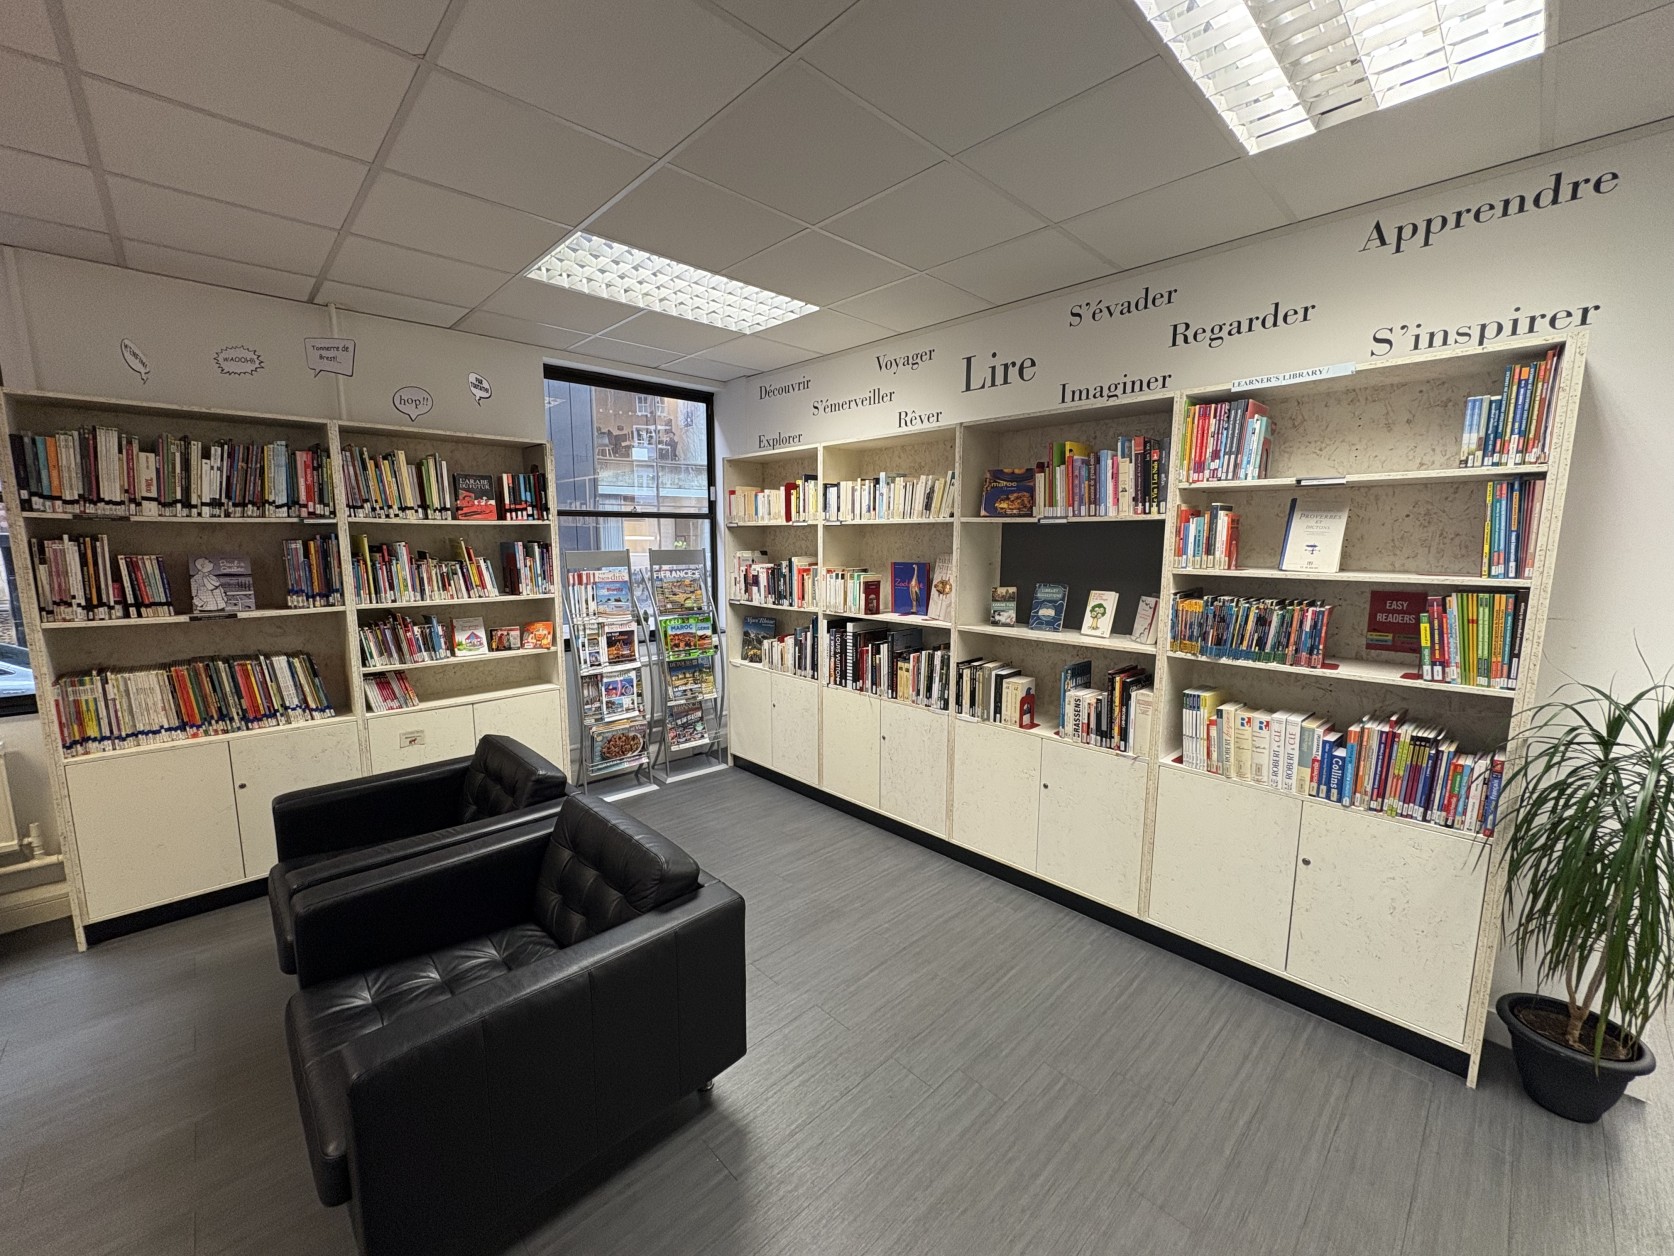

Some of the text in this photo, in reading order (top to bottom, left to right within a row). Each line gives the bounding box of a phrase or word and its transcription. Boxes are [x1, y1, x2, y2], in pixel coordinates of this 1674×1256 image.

[1361, 167, 1621, 255] Apprendre
[1069, 285, 1178, 328] S'évader
[1169, 302, 1317, 349] Regarder
[1370, 304, 1602, 359] S'inspirer
[311, 344, 350, 352] Tonnerre de
[876, 349, 935, 375] Voyager
[961, 351, 1037, 393] Lire
[759, 376, 811, 400] Découvrir
[1060, 372, 1172, 404] Imaginer
[1232, 375, 1280, 388] LEARNER'S
[1282, 368, 1325, 381] LIBRARY
[399, 395, 429, 410] hop!!
[812, 388, 895, 416] S'émerveiller
[897, 410, 943, 429] Rêver
[758, 432, 803, 450] Explorer
[1377, 613, 1416, 624] READERS
[1386, 601, 1408, 610] EASY
[1272, 750, 1281, 777] ROBERT
[1286, 753, 1295, 780] ROBERT
[1330, 758, 1342, 789] Collins
